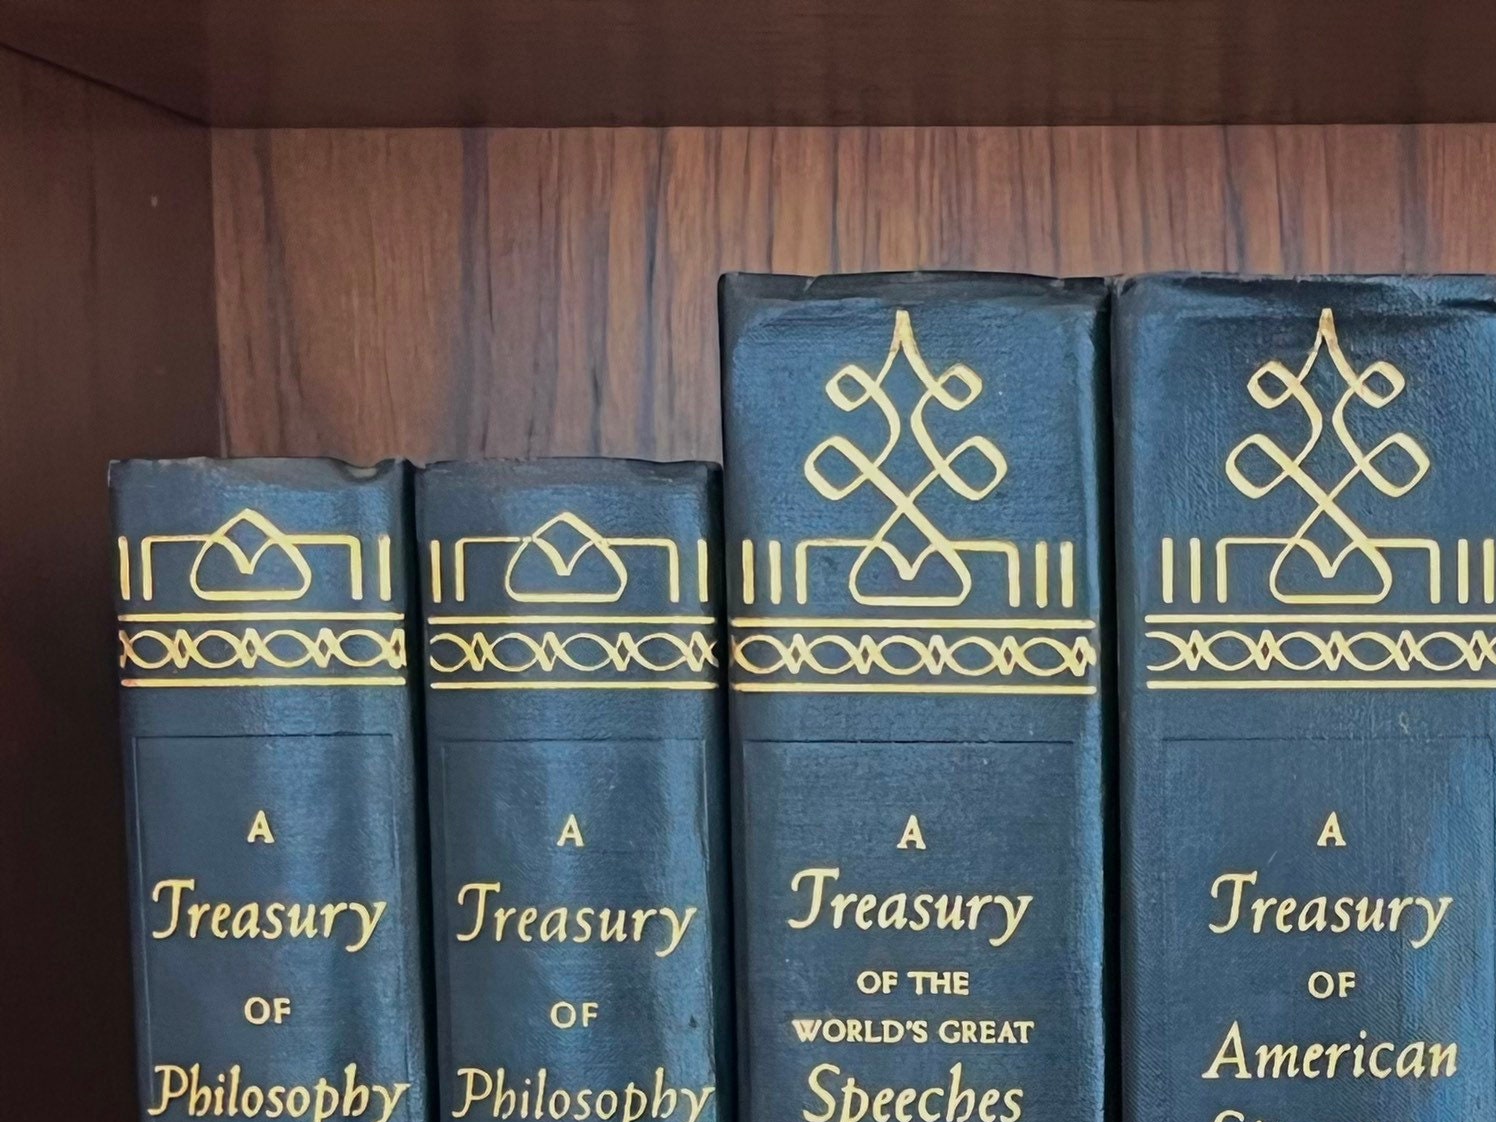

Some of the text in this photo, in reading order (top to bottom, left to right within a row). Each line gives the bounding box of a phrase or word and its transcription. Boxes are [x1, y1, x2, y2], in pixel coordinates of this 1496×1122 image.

[247, 810, 275, 844] A
[556, 813, 585, 848] A
[899, 816, 925, 850] A
[1318, 812, 1345, 847] A
[151, 878, 387, 953] Treasury
[456, 881, 696, 957] Treasury
[789, 867, 1031, 947] Treasury
[1211, 871, 1451, 946] Treasury
[856, 970, 970, 996] OF THE
[1307, 971, 1356, 999] OF
[243, 996, 291, 1025] OF
[549, 1001, 598, 1028] OF
[792, 1017, 1035, 1044] WORLD'S GREAT
[1202, 1023, 1458, 1079] American
